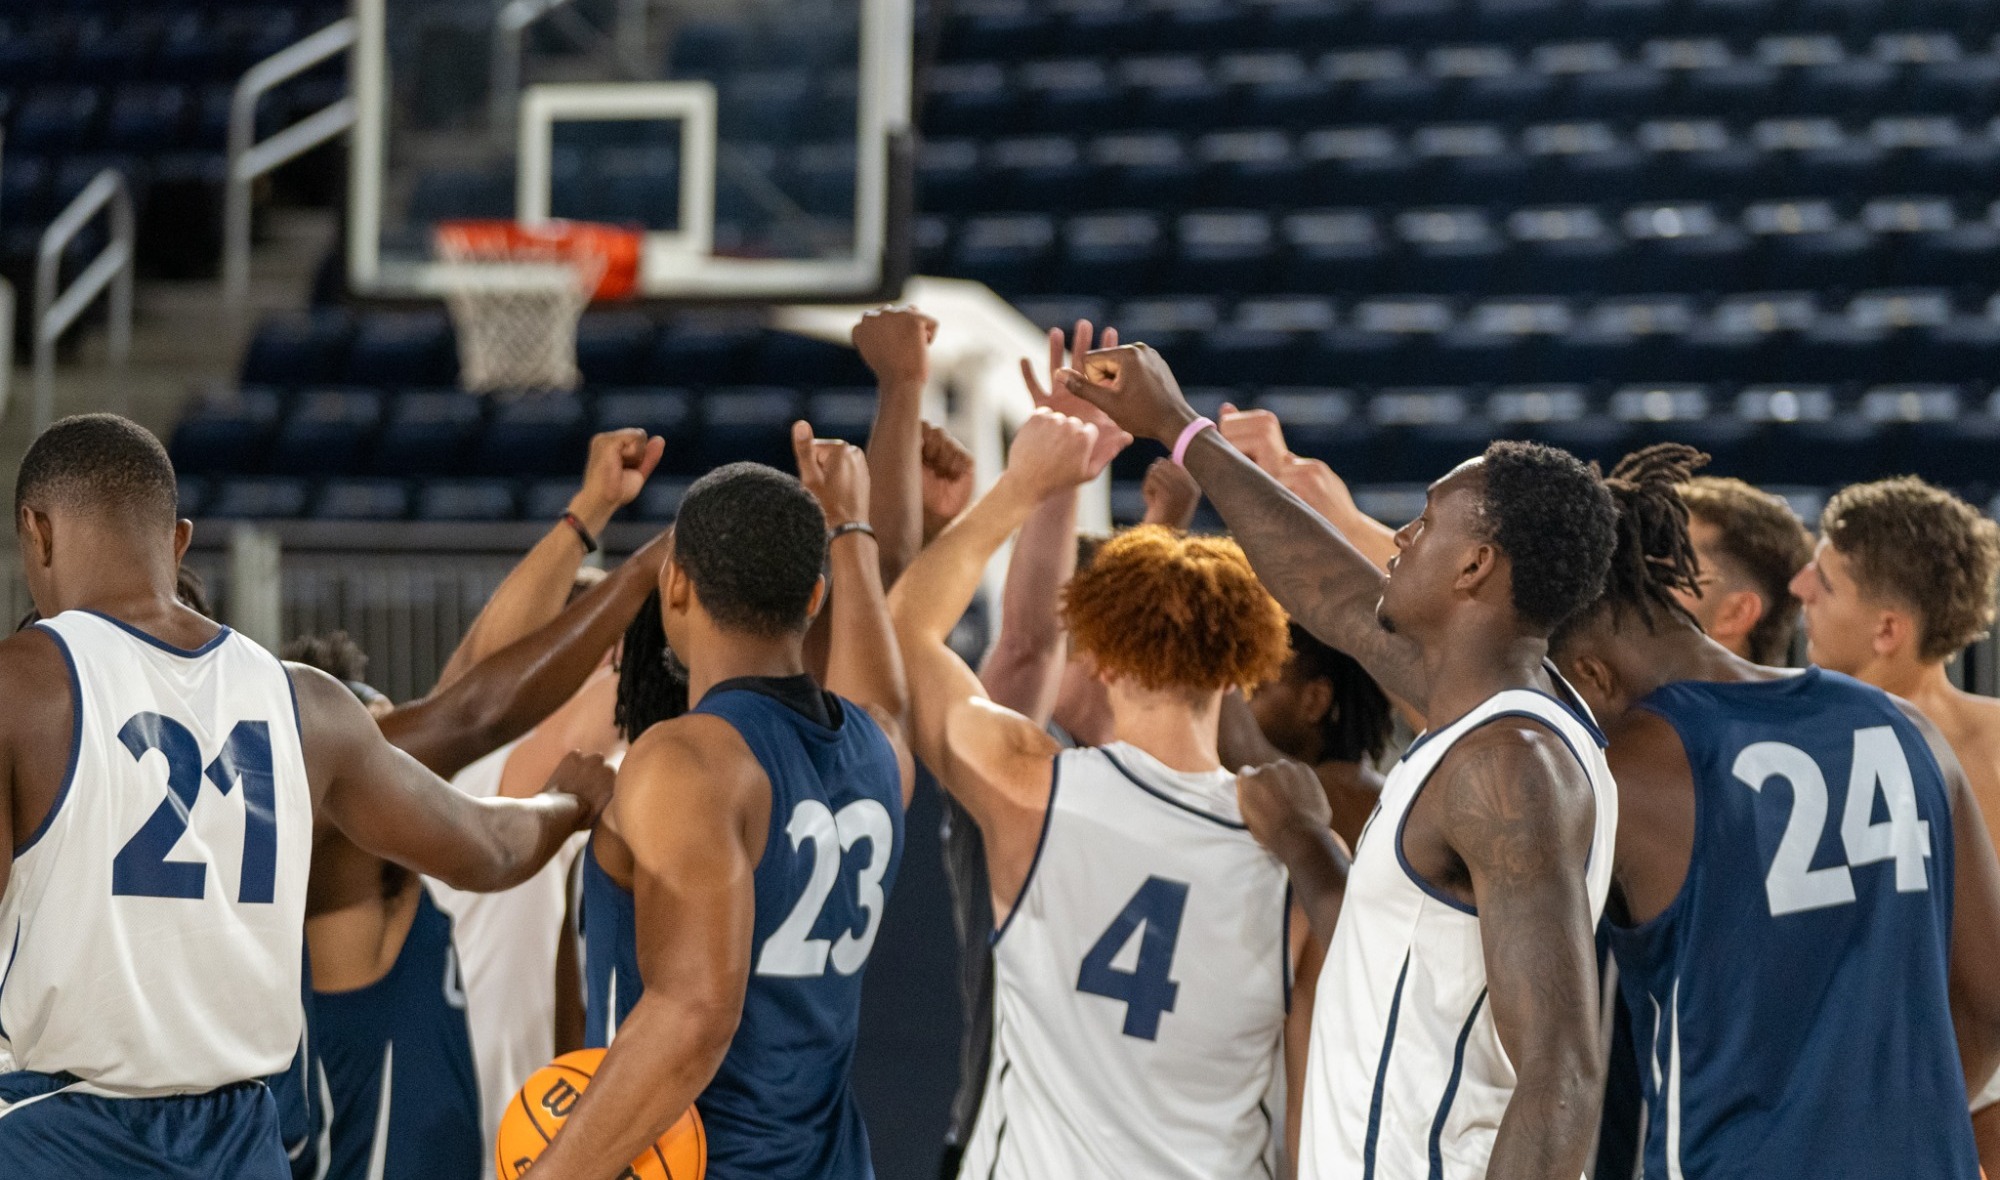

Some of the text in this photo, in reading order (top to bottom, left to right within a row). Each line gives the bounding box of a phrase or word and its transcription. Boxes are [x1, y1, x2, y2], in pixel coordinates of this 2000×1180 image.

[112, 711, 277, 904] 21
[755, 799, 893, 977] 23
[1732, 725, 1931, 917] 24
[1076, 874, 1191, 1041] 4
